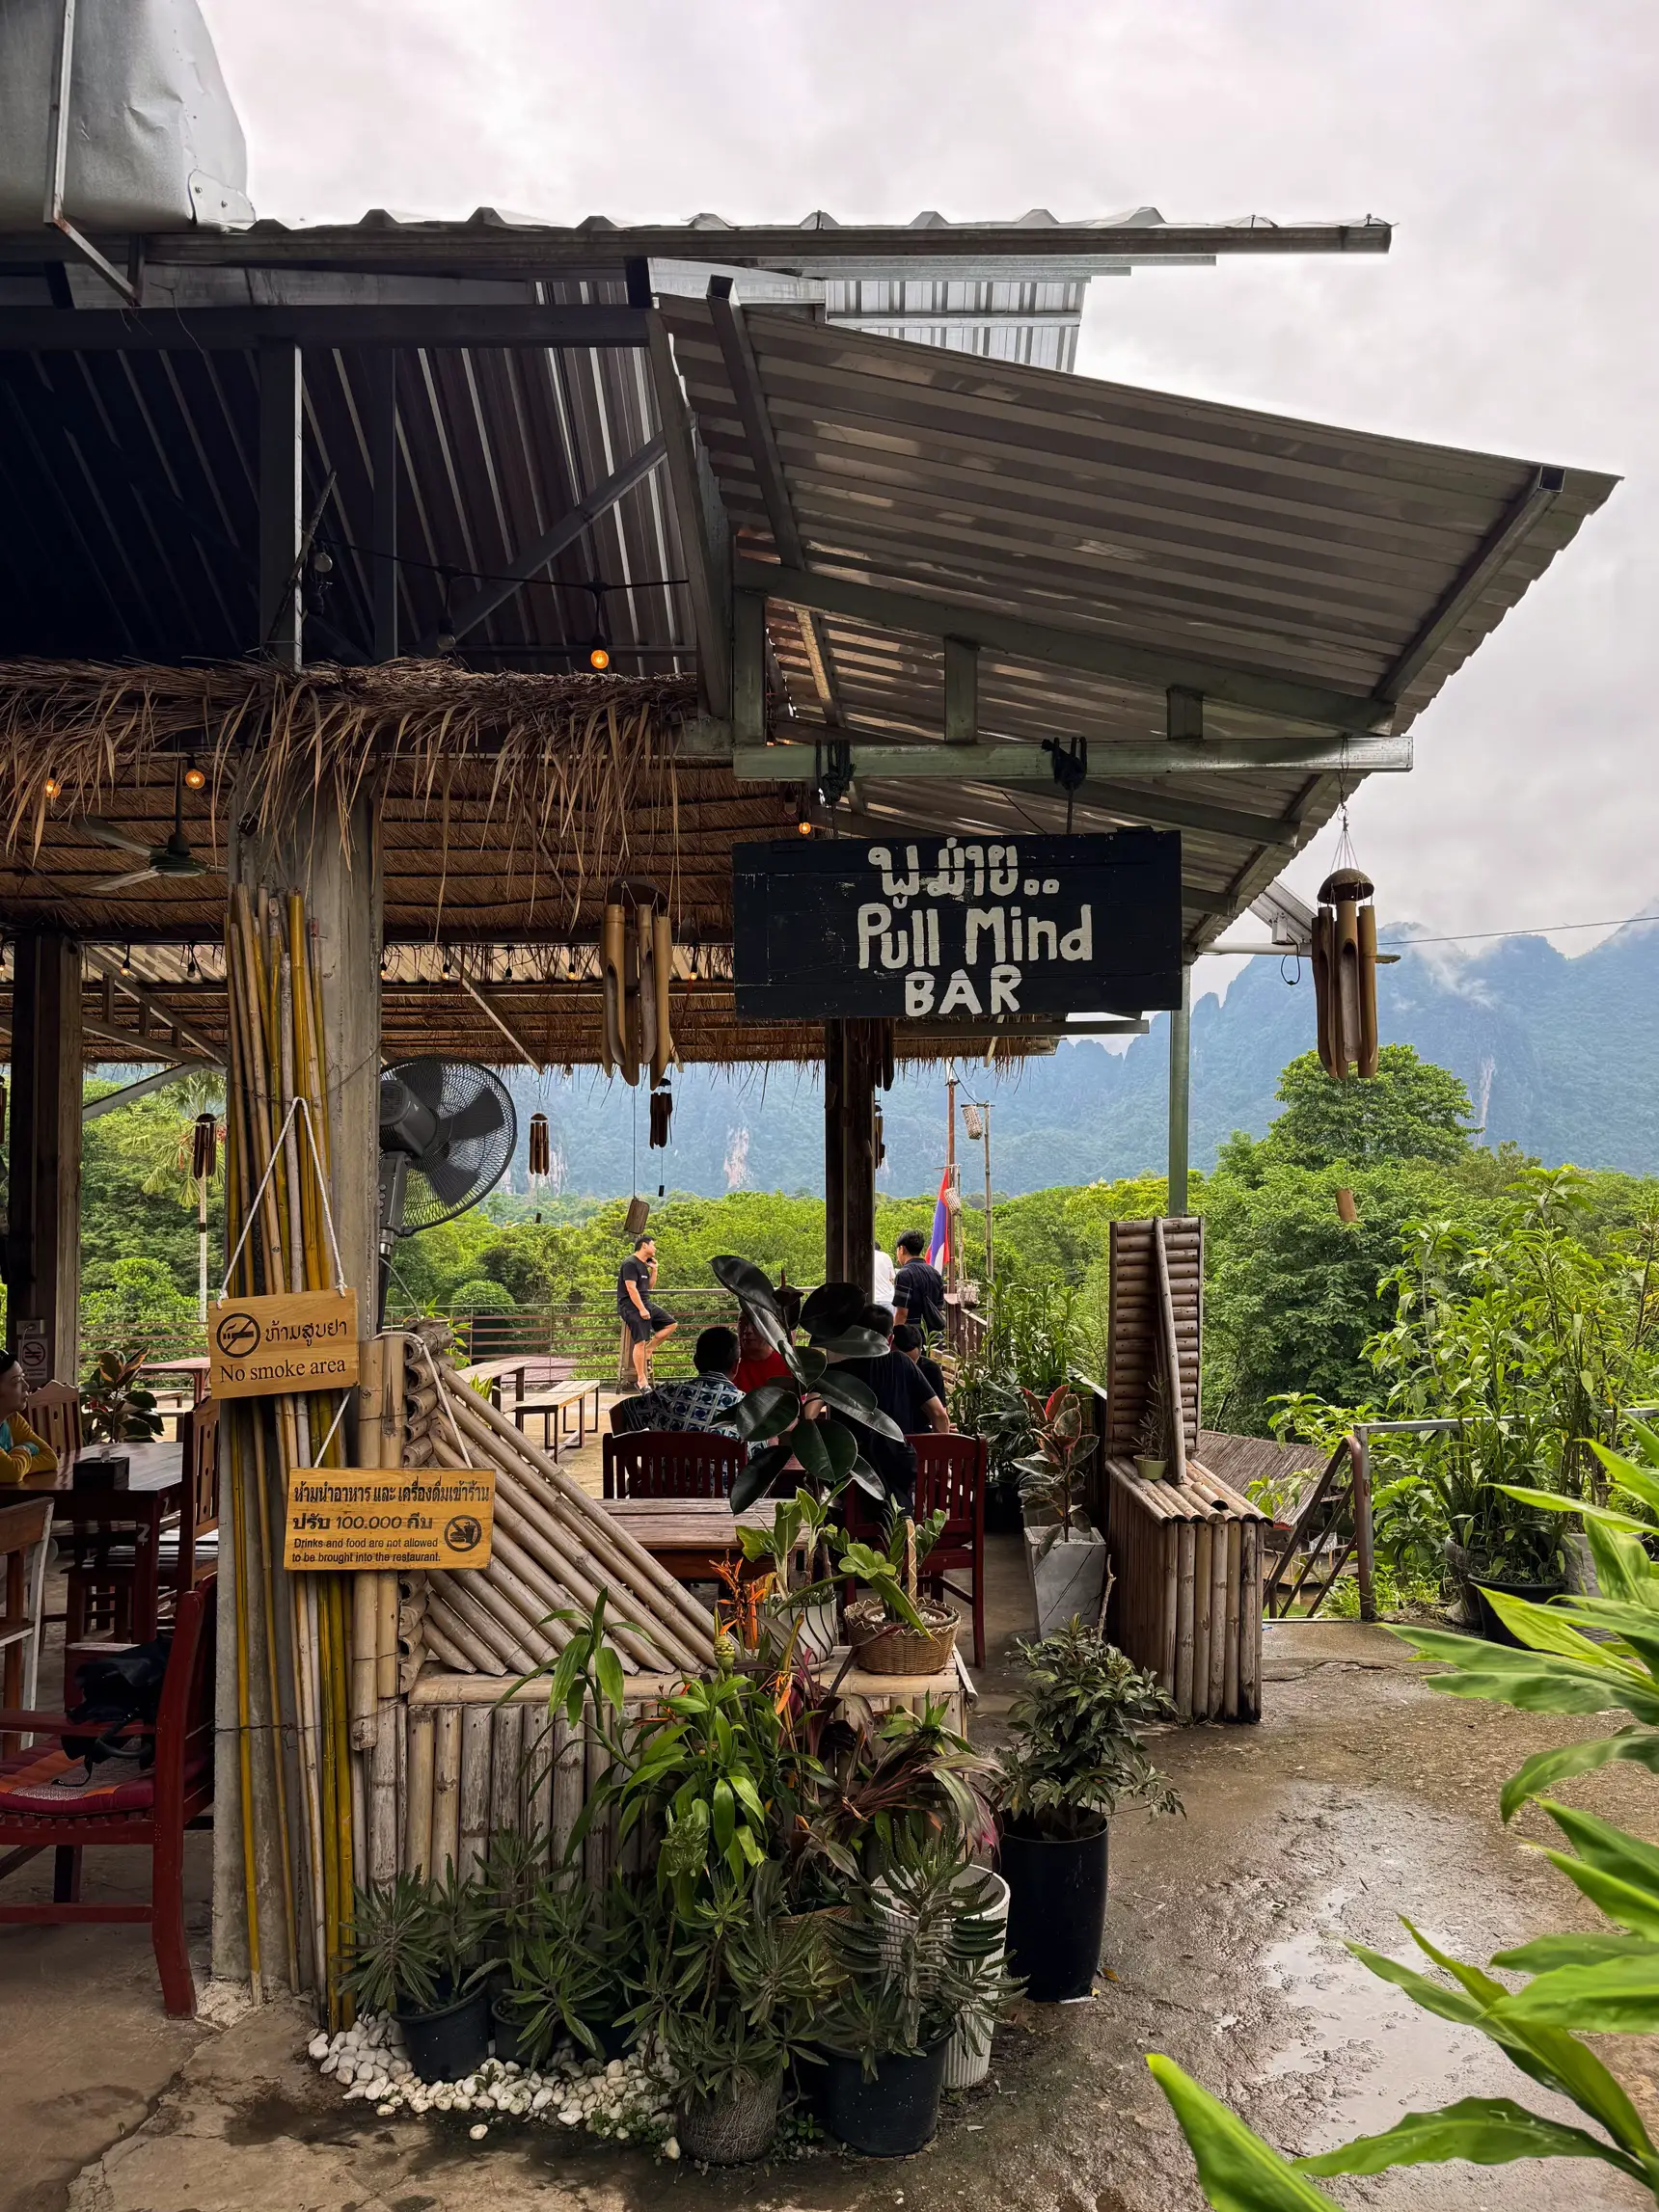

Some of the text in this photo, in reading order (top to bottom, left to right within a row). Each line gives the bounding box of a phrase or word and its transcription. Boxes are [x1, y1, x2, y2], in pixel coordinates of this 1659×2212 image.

[857, 903, 1093, 969] Pull Mind
[904, 964, 1022, 1016] BAR
[220, 1360, 346, 1383] No smoke area
[373, 1486, 396, 1502] และ
[292, 1512, 331, 1530] ปรับ
[336, 1516, 402, 1529] 100.000
[294, 1537, 438, 1549] Drinks and food are not allowed
[292, 1551, 441, 1564] to be brought into the restaurant.
